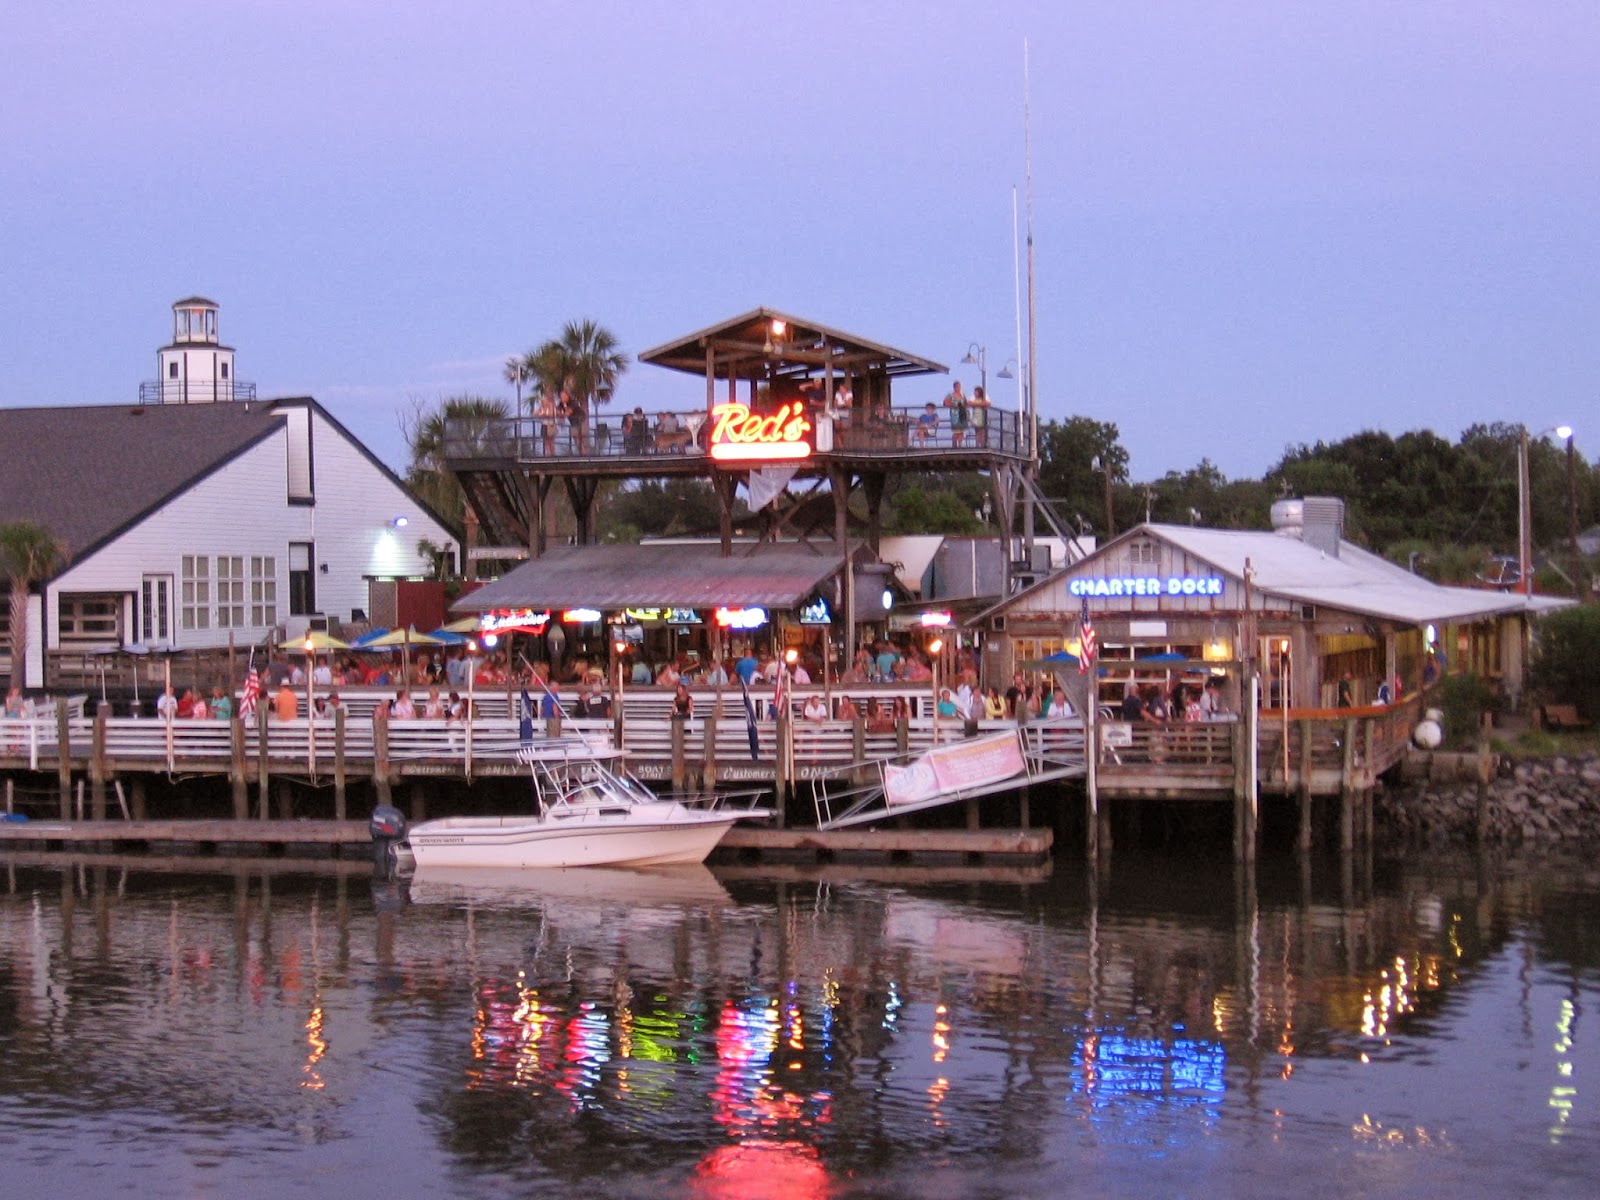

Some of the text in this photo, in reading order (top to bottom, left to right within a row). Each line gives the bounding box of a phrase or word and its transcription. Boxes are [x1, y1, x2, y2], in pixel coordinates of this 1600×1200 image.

[711, 401, 811, 443] Red's
[1070, 577, 1221, 596] CHARTER DOCK
[723, 765, 777, 779] Customers
